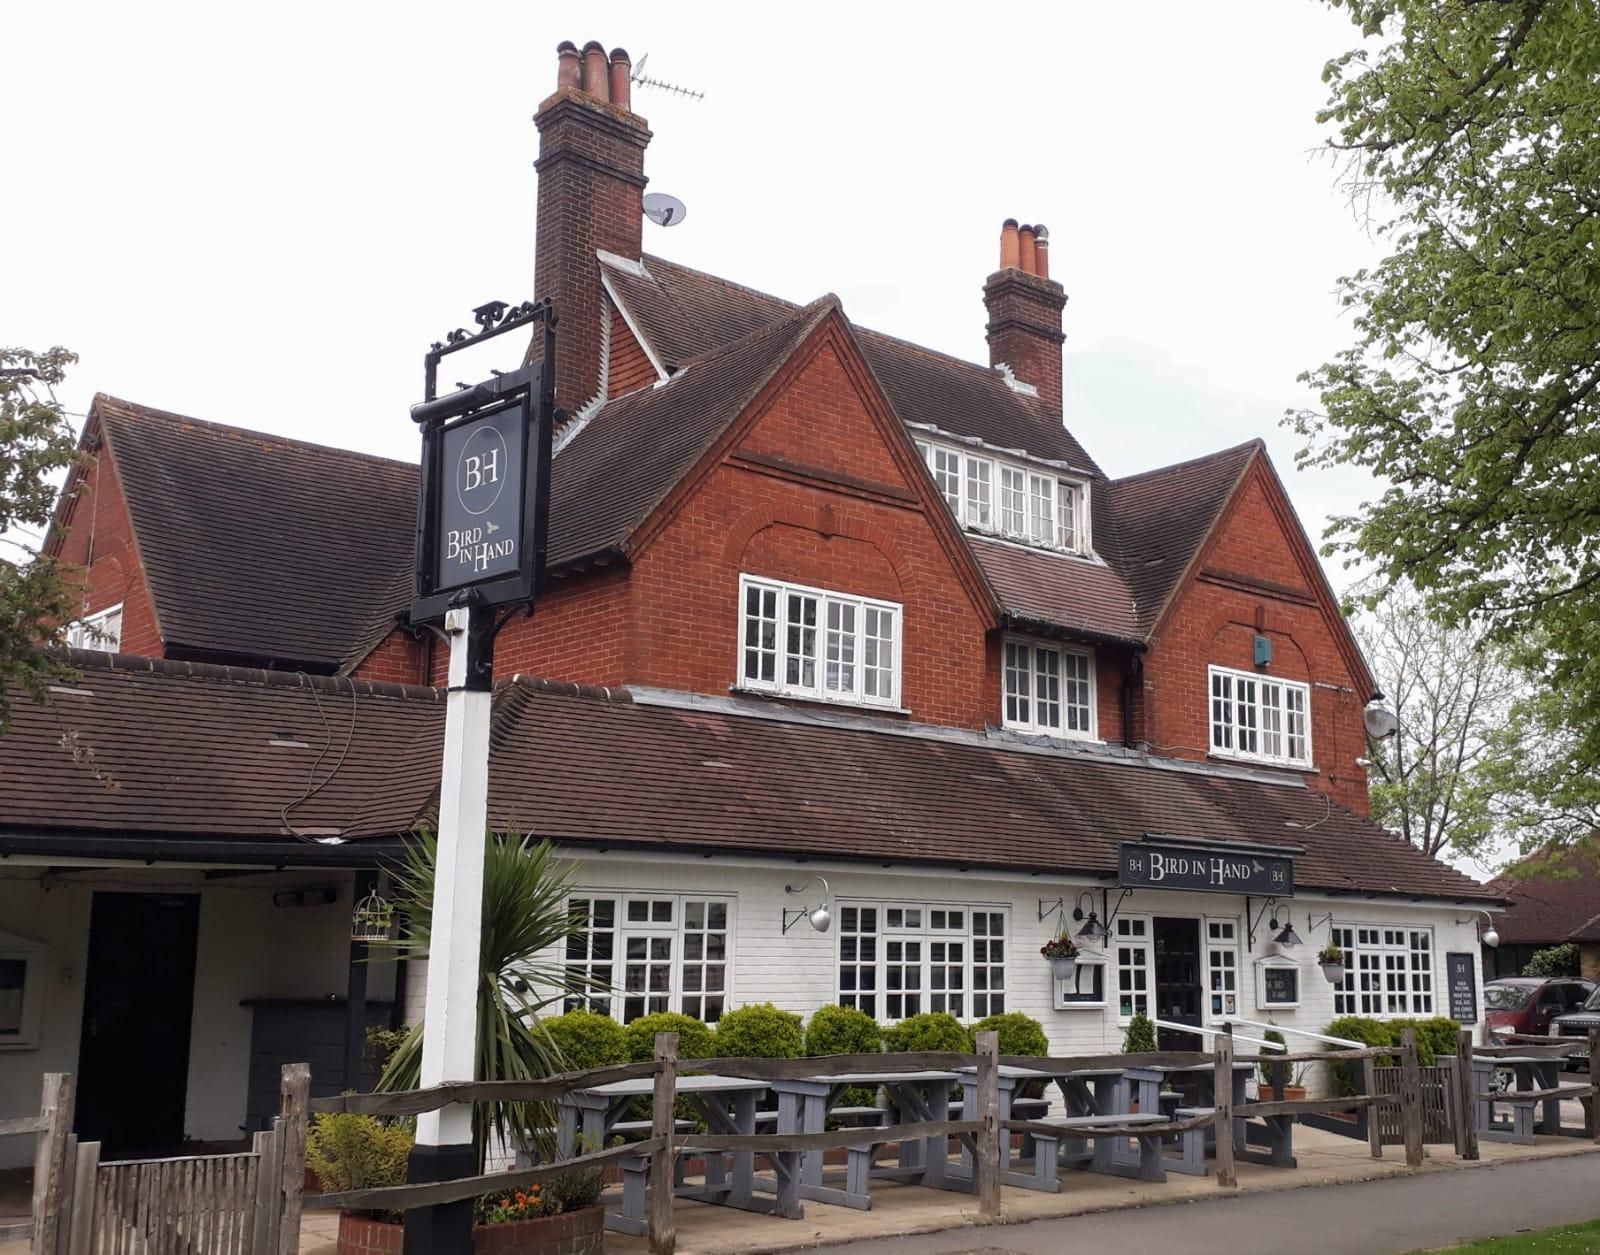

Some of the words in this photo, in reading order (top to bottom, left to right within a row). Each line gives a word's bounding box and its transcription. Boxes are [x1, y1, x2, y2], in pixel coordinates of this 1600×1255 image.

[464, 448, 499, 491] BH
[446, 527, 482, 560] BIRD
[459, 547, 473, 564] IN
[473, 538, 514, 572] HAND
[1149, 853, 1188, 881] BIRD
[1192, 860, 1206, 875] IN
[1209, 858, 1250, 885] HAND
